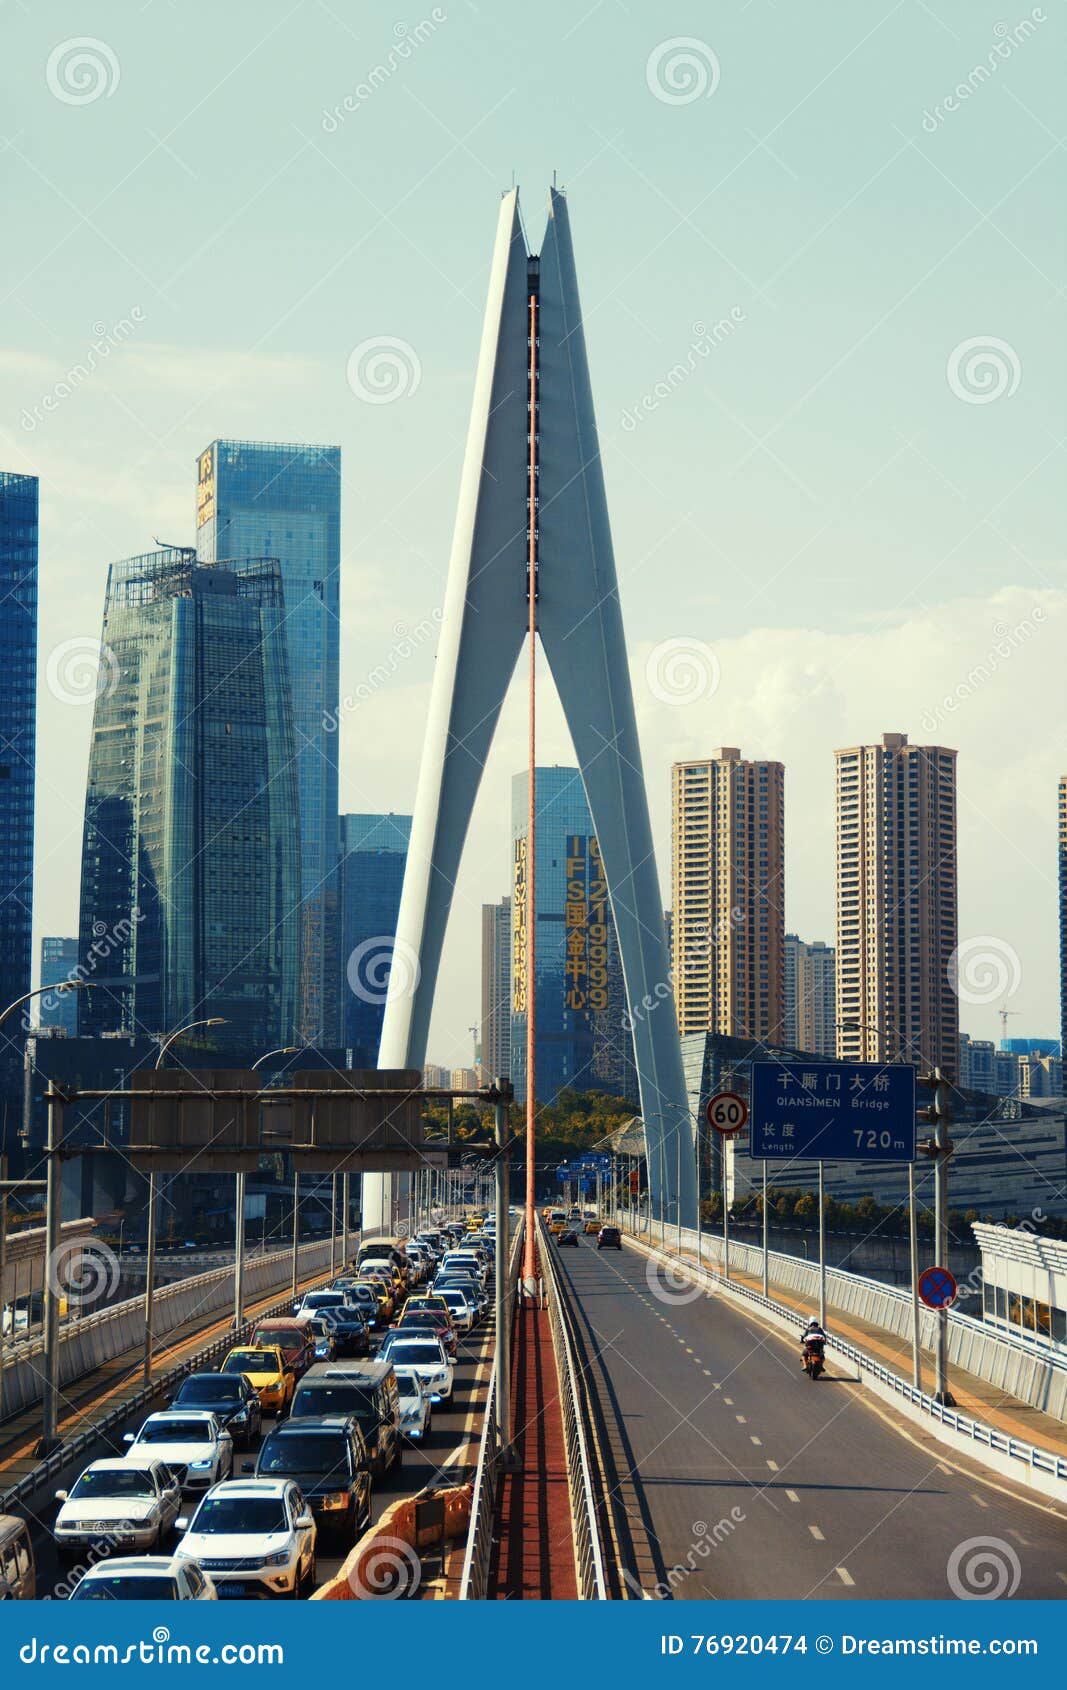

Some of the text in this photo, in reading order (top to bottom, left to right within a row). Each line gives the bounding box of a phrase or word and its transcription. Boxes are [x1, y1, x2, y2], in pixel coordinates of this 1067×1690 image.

[777, 1072, 890, 1092] 千厮门大桥
[777, 1096, 890, 1111] QIANSIMEN Bridge
[715, 1103, 739, 1124] 60
[762, 1122, 795, 1137] 长度
[762, 1142, 794, 1152] Length
